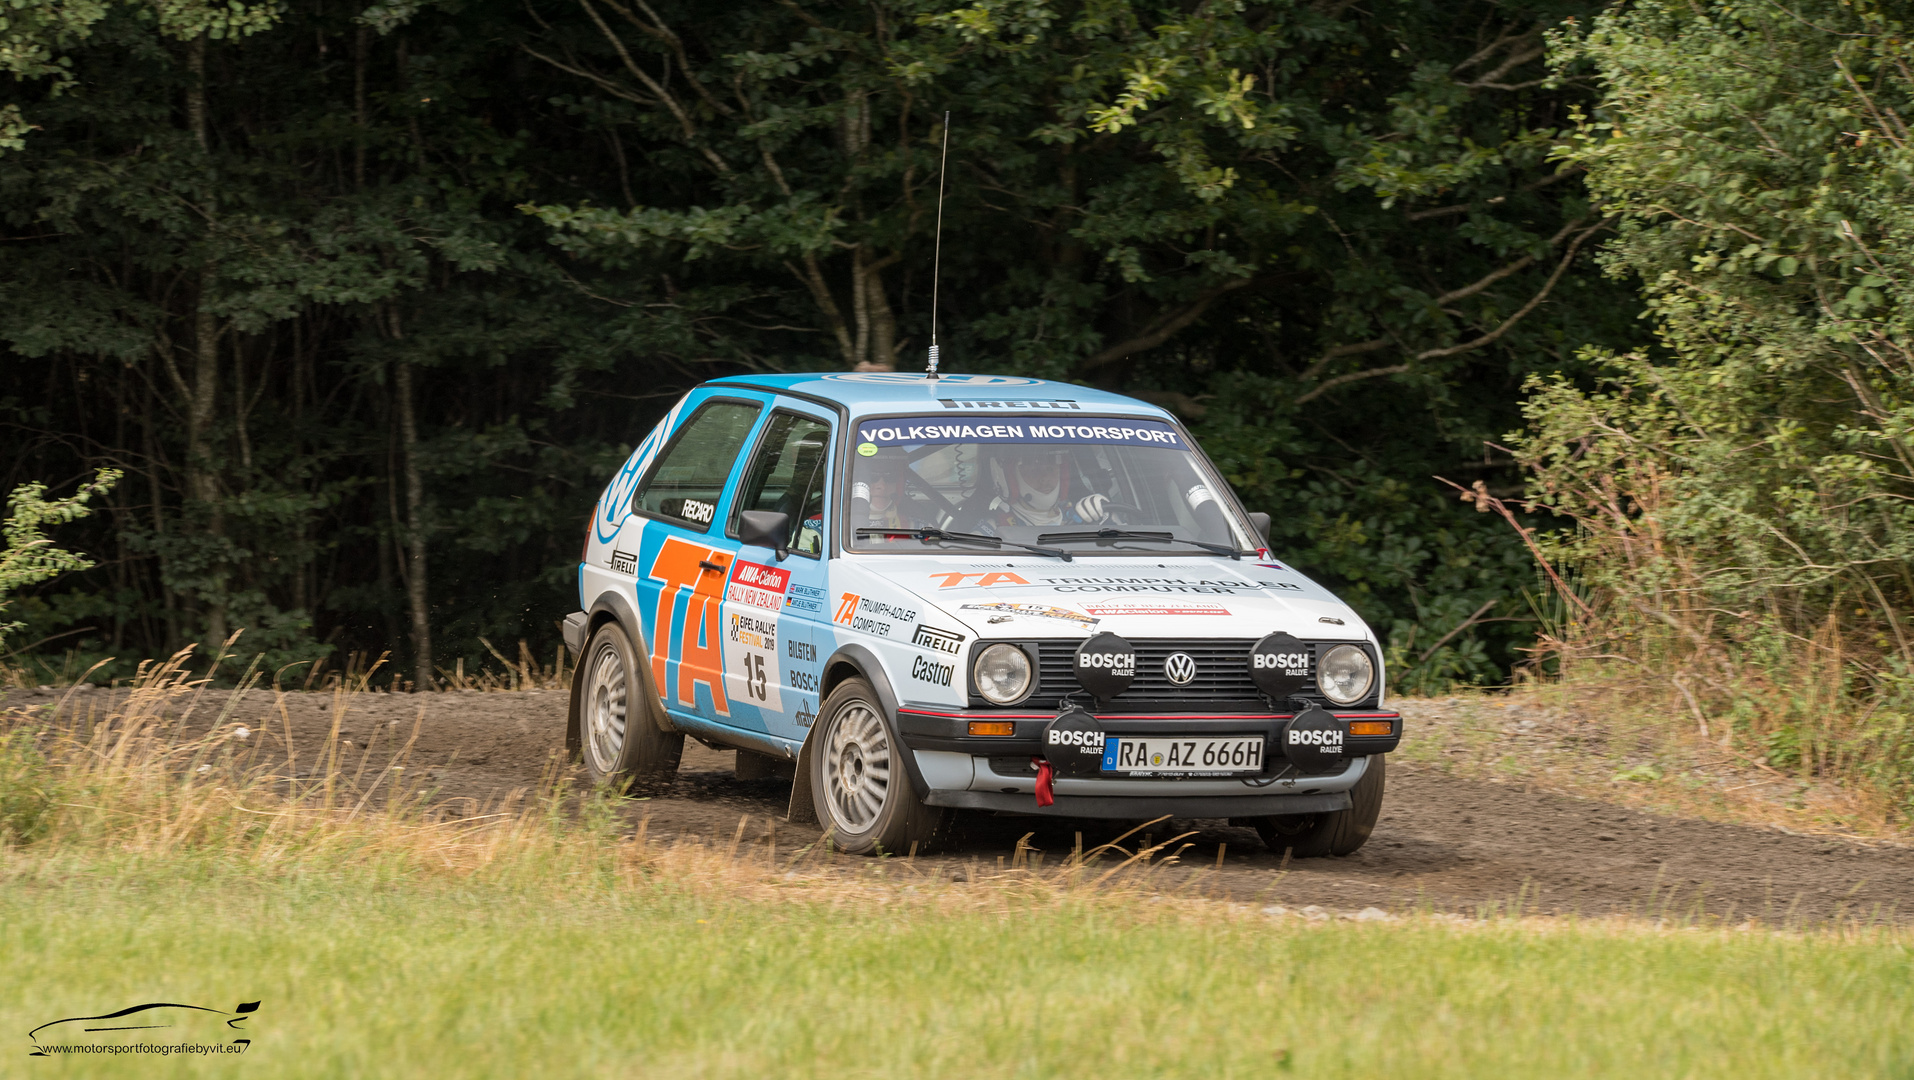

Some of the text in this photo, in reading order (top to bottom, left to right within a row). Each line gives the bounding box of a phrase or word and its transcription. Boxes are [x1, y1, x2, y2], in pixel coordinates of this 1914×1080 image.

[937, 399, 1081, 410] PIRELLI
[861, 424, 1178, 445] VOLKSWAGEN MOTORSPORT
[681, 498, 714, 523] RECARO
[610, 549, 638, 575] PIRELLI
[929, 572, 1031, 588] TA
[1038, 578, 1302, 591] TRIUMPH-ADLER
[1053, 586, 1237, 595] COMPUTER
[726, 585, 782, 611] RALLY NEW ZEALAND
[833, 592, 861, 626] TA
[859, 597, 917, 623] TRIUMPH-ADLER
[648, 535, 737, 718] TA
[740, 616, 776, 637] EIFEL RALLYE
[852, 616, 891, 637] COMPUTER
[739, 631, 775, 651] FESTIVAL 2019
[911, 623, 966, 655] PIRELLI
[788, 640, 817, 662] BILSTEIN
[1079, 653, 1135, 669] BOSCH
[1253, 653, 1309, 669] BOSCH
[743, 651, 767, 702] 15
[911, 655, 955, 688] Castrol
[1111, 669, 1134, 677] RALLYE
[1166, 653, 1195, 682] VW
[1285, 669, 1308, 677] RALLYE
[789, 669, 819, 693] BOSCH
[1048, 729, 1105, 747] BOSCH
[1288, 729, 1343, 746] BOSCH
[1080, 746, 1104, 755] RALLYE
[1119, 742, 1260, 767] RA AZ 666H
[1320, 746, 1343, 754] RALLYE
[1106, 757, 1113, 765] D
